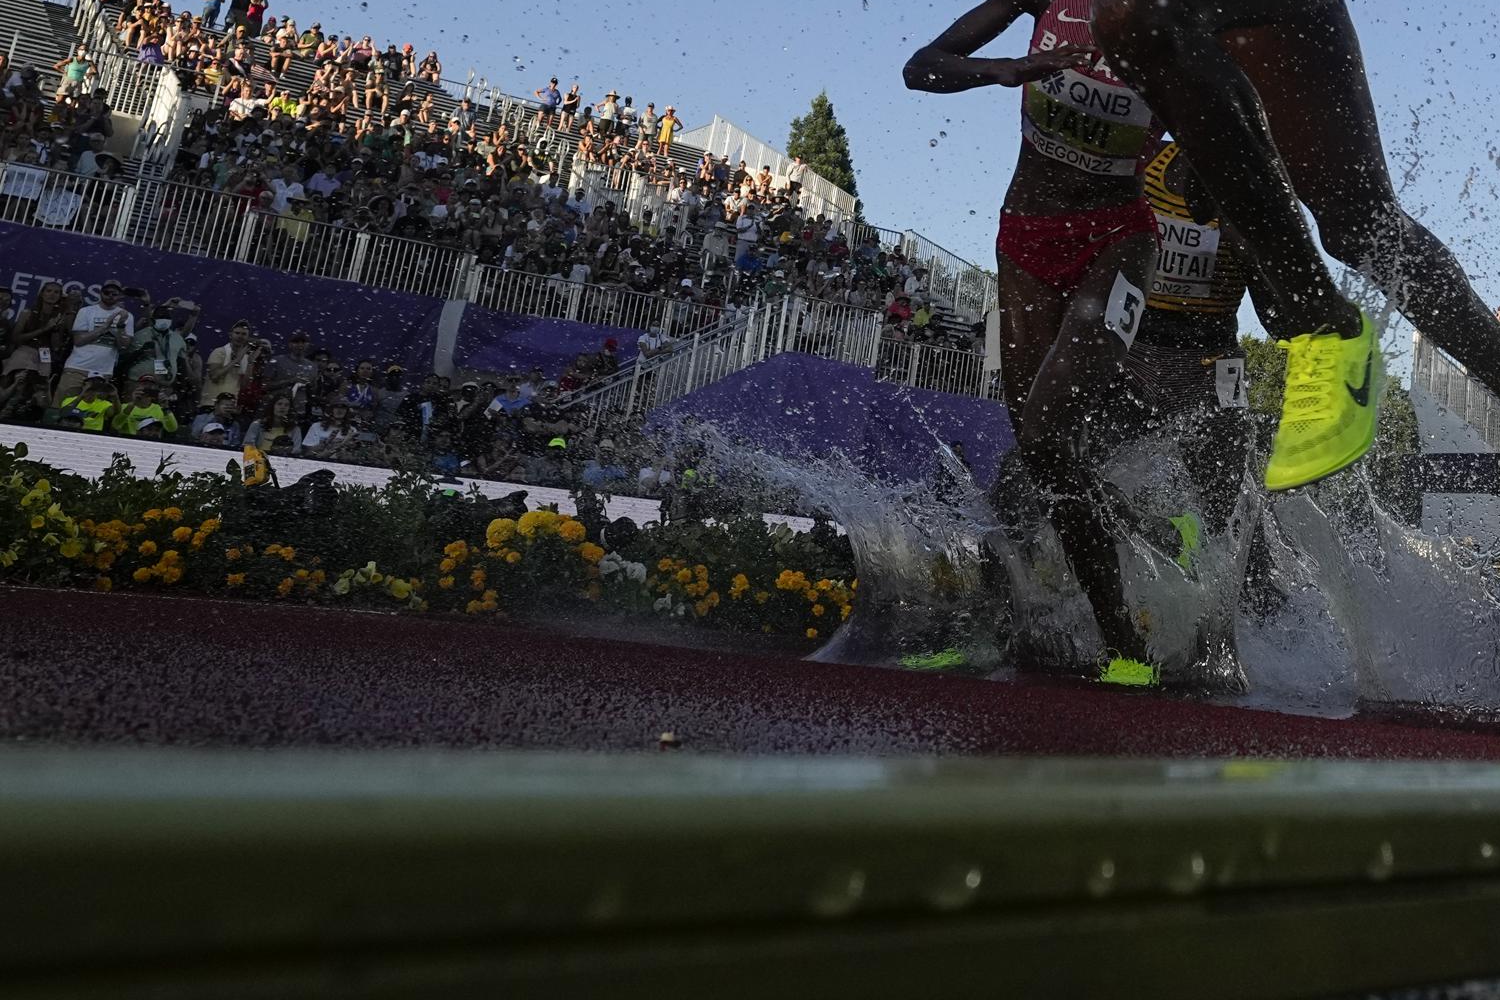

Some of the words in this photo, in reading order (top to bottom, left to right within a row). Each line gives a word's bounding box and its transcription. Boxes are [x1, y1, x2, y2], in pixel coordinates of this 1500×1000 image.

[1069, 81, 1132, 117] QNB
[1032, 131, 1114, 173] OREGON22
[1119, 292, 1140, 334] 5
[1228, 366, 1240, 400] 7
